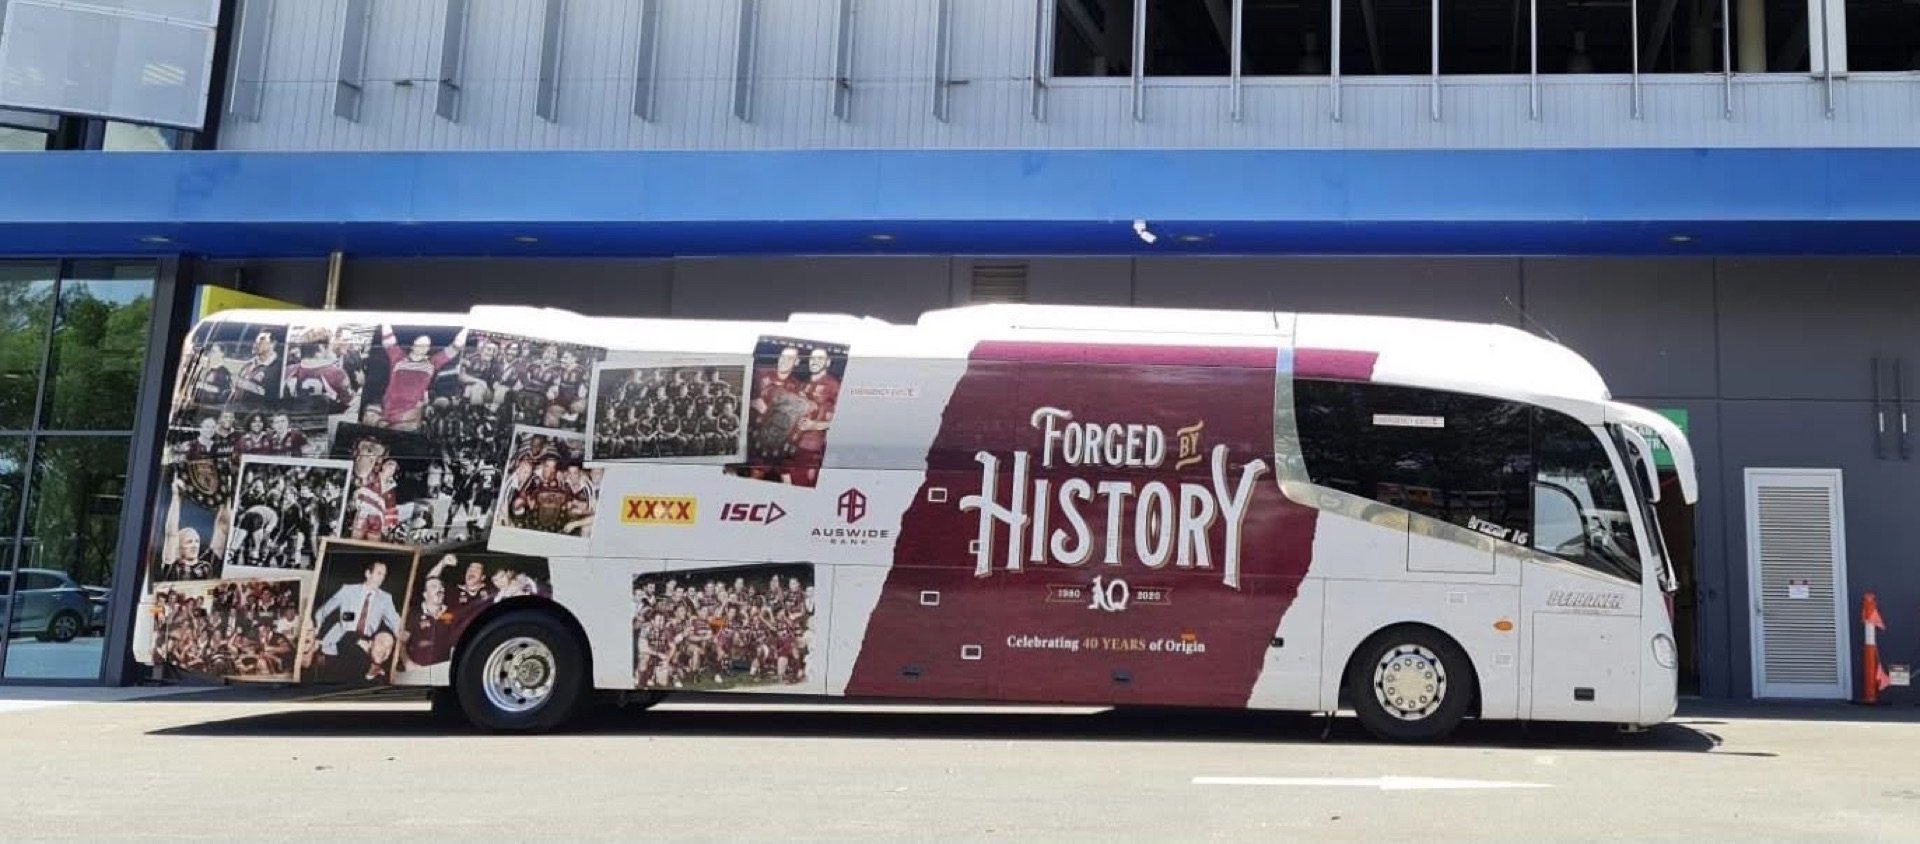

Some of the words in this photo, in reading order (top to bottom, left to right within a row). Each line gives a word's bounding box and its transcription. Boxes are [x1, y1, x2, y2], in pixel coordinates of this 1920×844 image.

[1031, 407, 1166, 468] FORGED
[1179, 432, 1200, 458] BY
[626, 500, 692, 520] XXXX
[959, 444, 1270, 590] HISTORY
[811, 528, 890, 539] AUSWIDE
[1058, 588, 1081, 599] 1980
[1136, 591, 1161, 601] 2020
[1006, 634, 1080, 652] Celebrating
[1082, 637, 1098, 649] 40
[1102, 638, 1146, 650] YEARS
[1149, 639, 1163, 651] of
[1165, 640, 1206, 654] Origin
